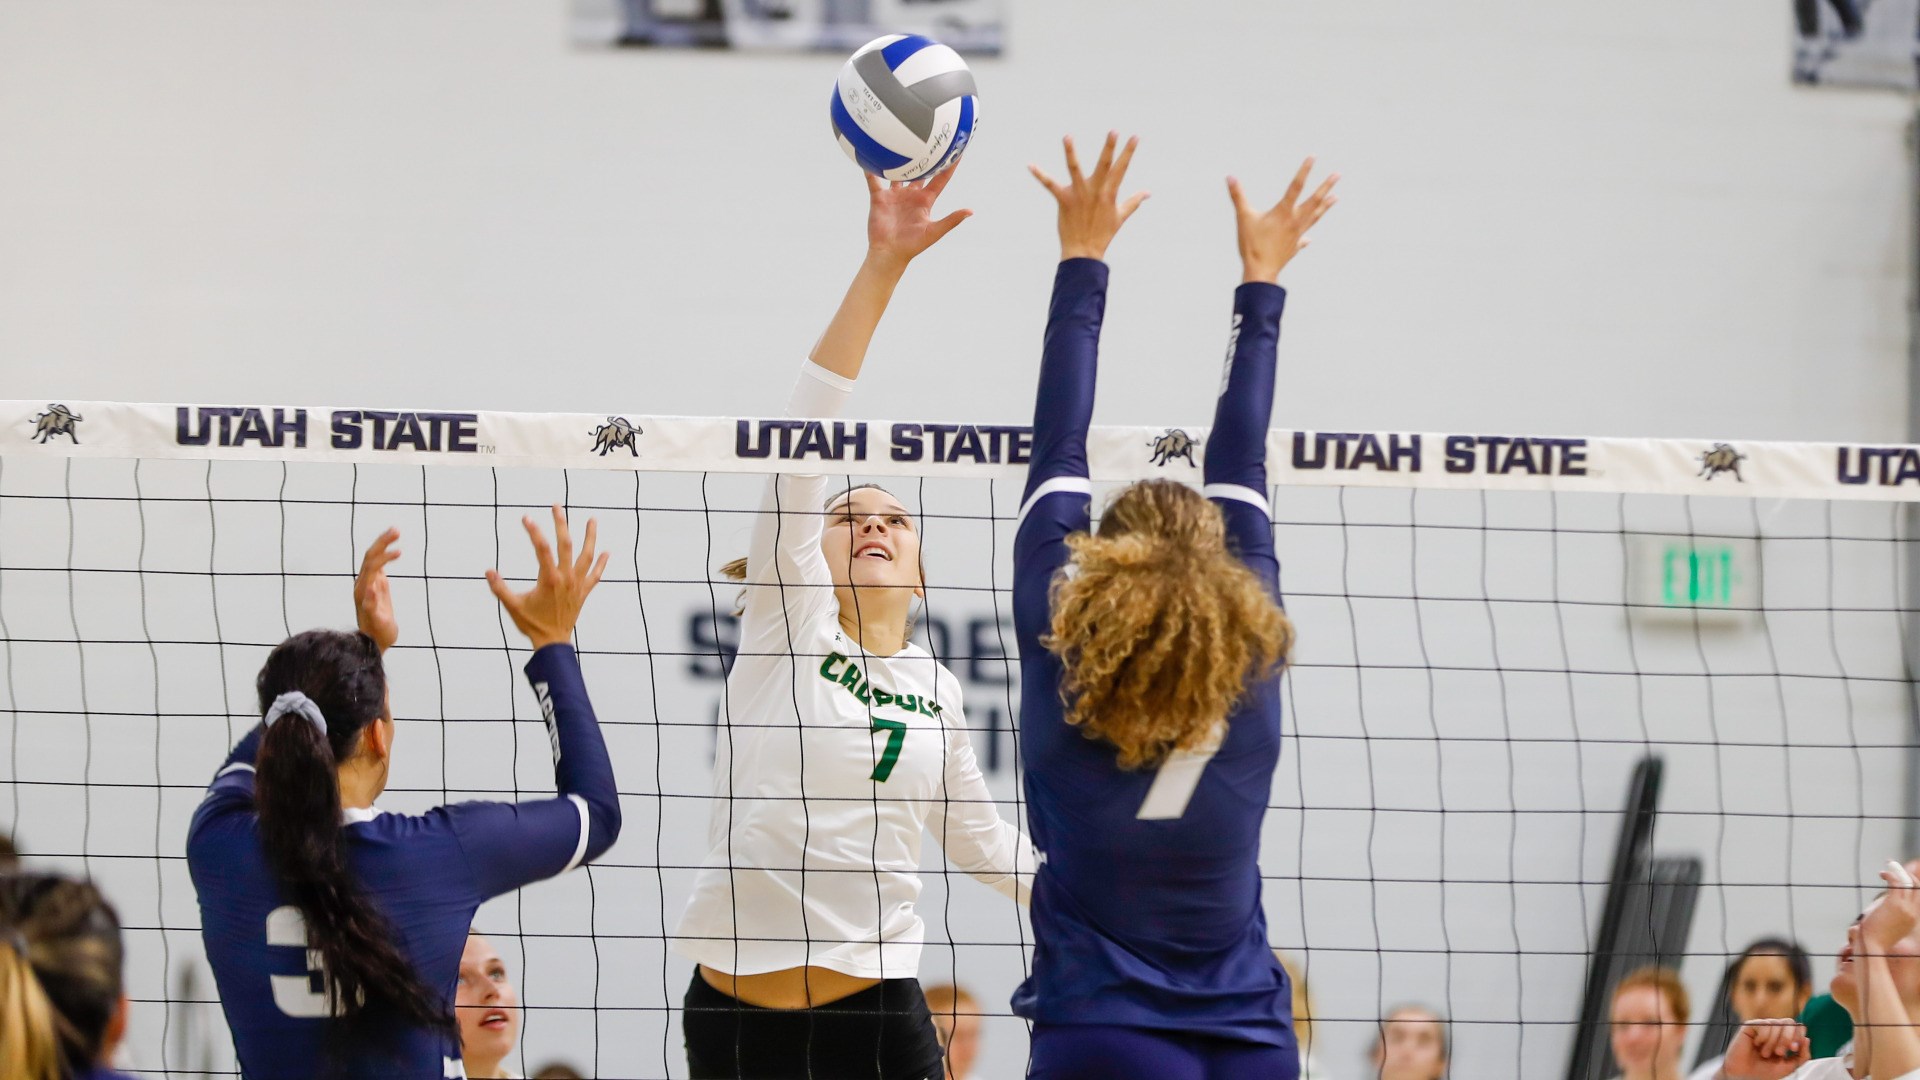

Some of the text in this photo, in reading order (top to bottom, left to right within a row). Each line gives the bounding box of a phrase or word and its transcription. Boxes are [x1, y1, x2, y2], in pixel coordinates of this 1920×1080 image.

[930, 122, 951, 156] Super
[176, 407, 307, 448] UTAH
[330, 410, 478, 452] STATE
[735, 420, 1033, 464] UTAH STATE
[1291, 432, 1588, 476] UTAH STATE
[869, 714, 908, 783] 7
[265, 904, 366, 1019] 3
